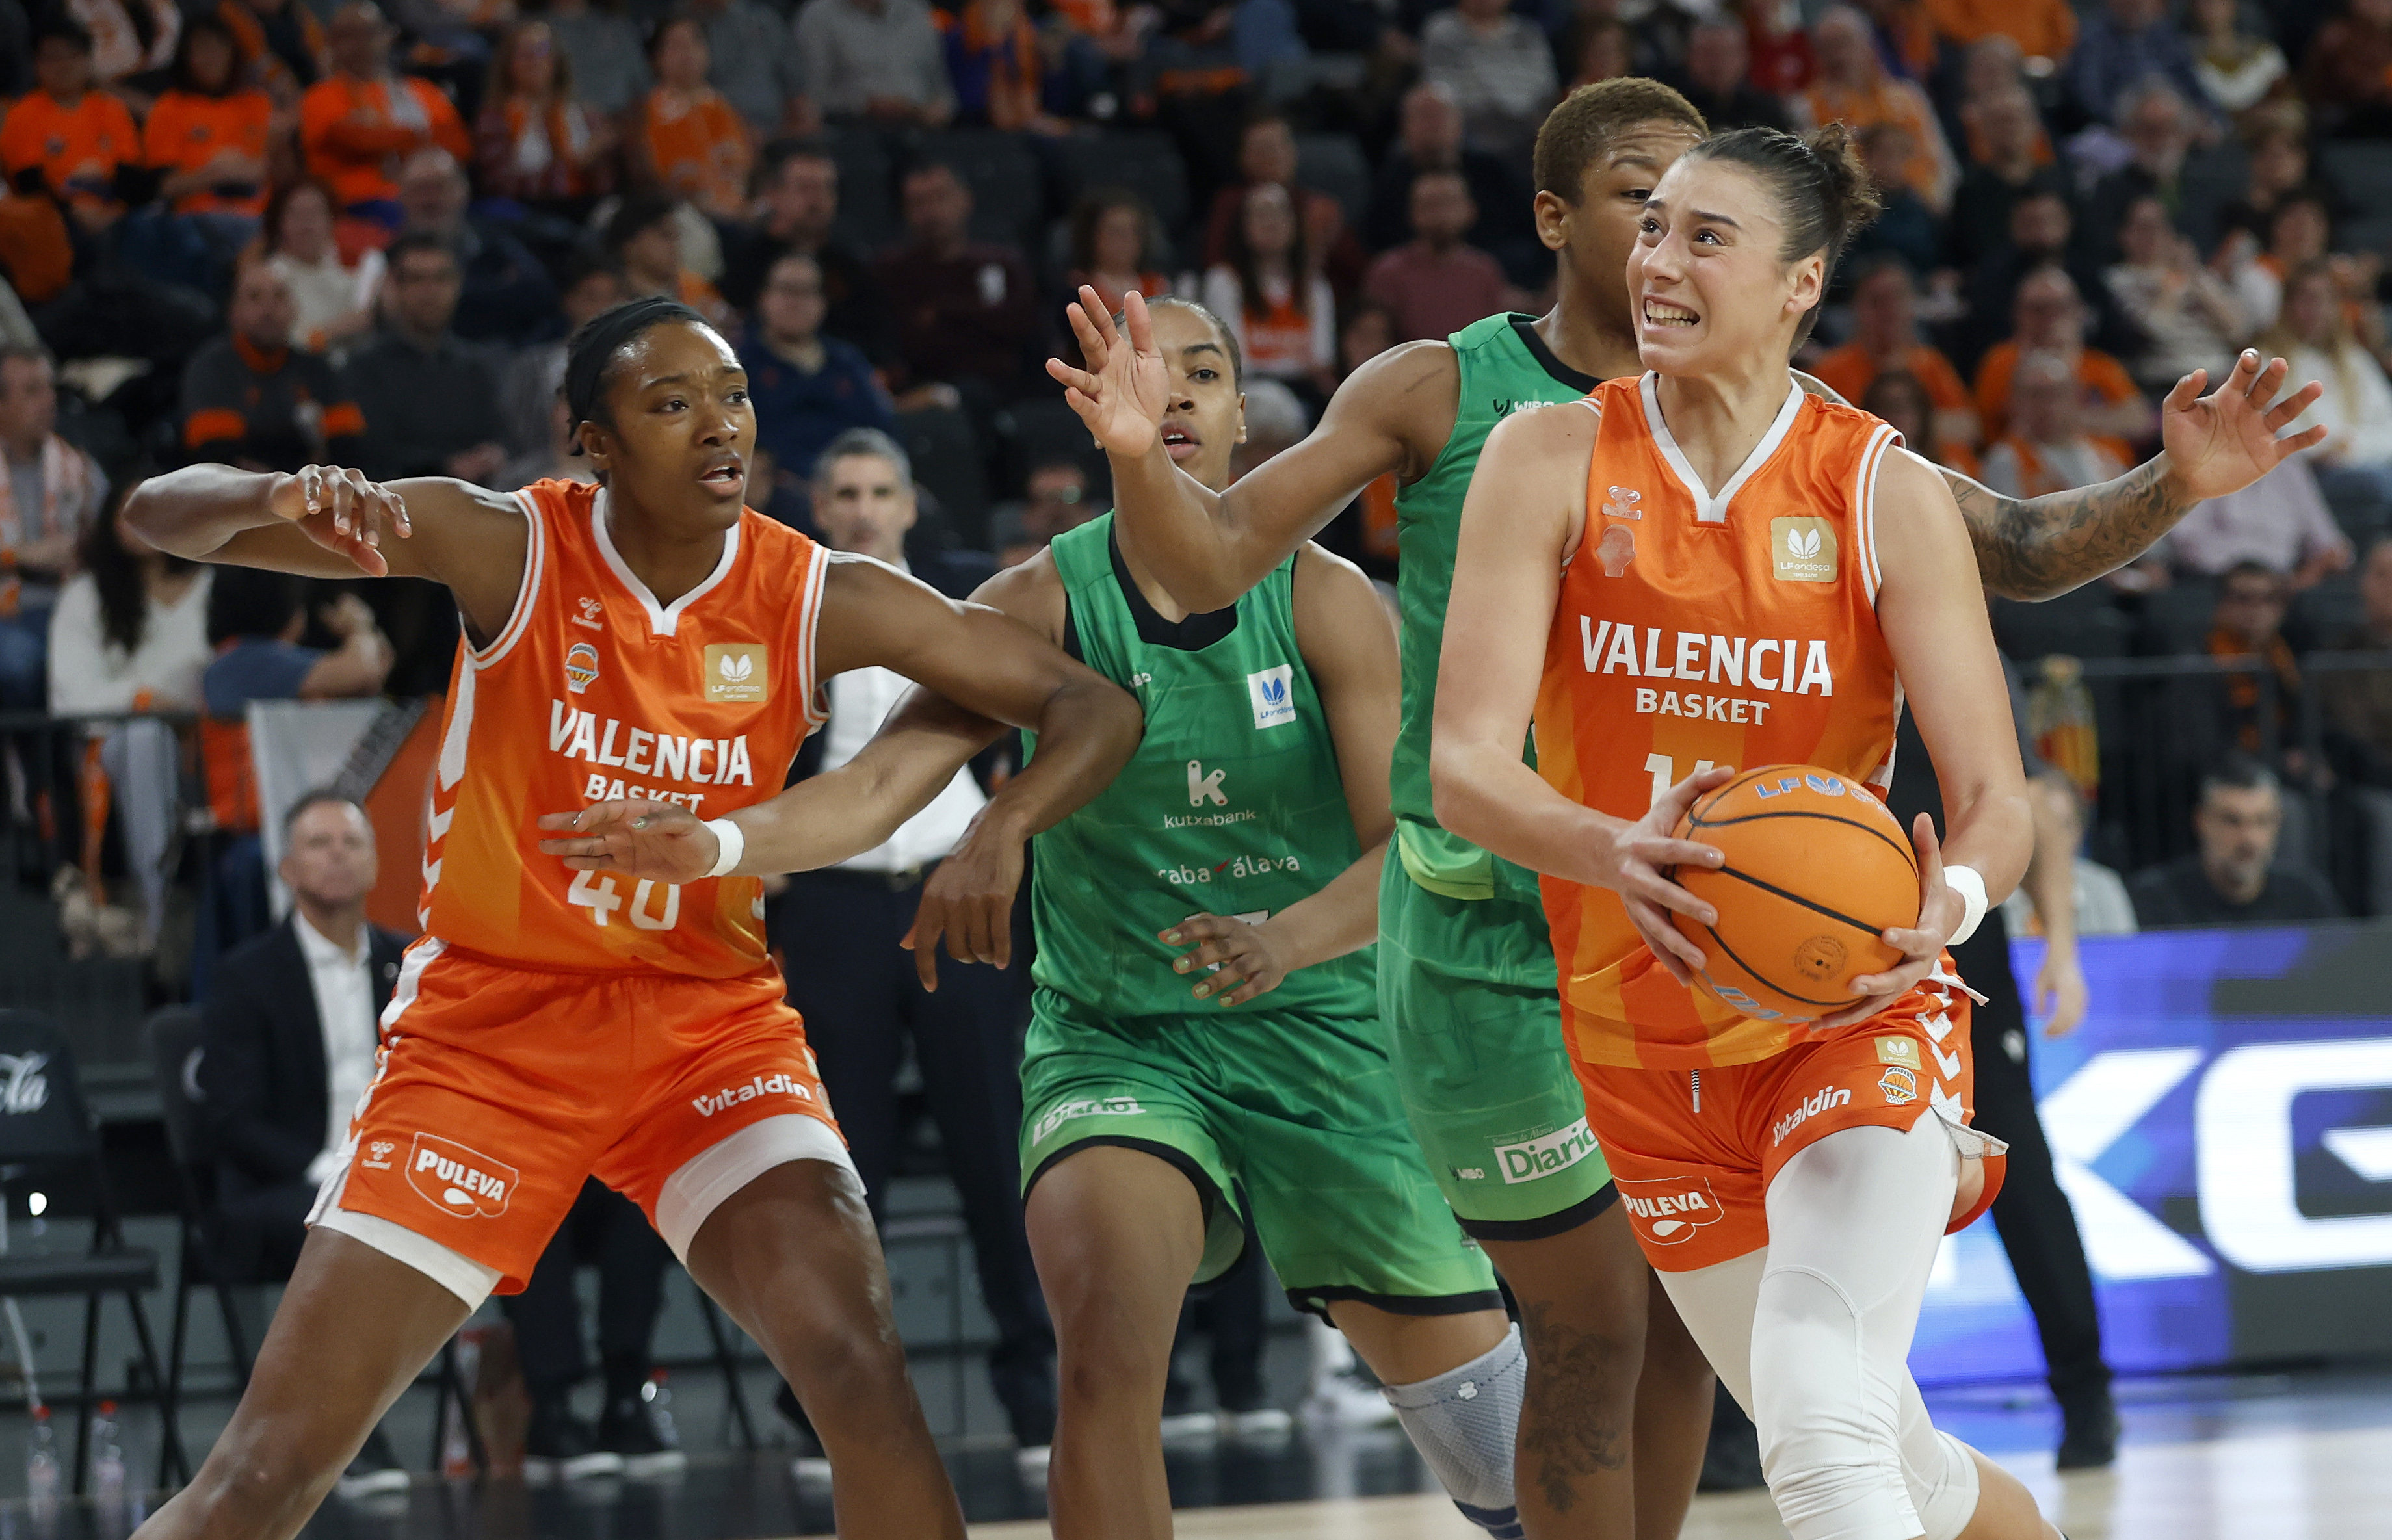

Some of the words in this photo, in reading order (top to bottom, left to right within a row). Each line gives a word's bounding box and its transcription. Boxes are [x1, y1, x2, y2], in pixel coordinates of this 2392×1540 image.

[1579, 614, 1832, 696] VALENCIA
[1636, 688, 1770, 725] BASKET
[549, 699, 753, 786] VALENCIA
[1755, 777, 1802, 800] LF
[1164, 810, 1257, 829] kutxabank
[1233, 855, 1300, 878] álava
[567, 869, 681, 930] 40
[692, 1074, 811, 1117] Vitaldin
[415, 1149, 506, 1201] PULEVA
[1622, 1192, 1710, 1218] PULEVA
